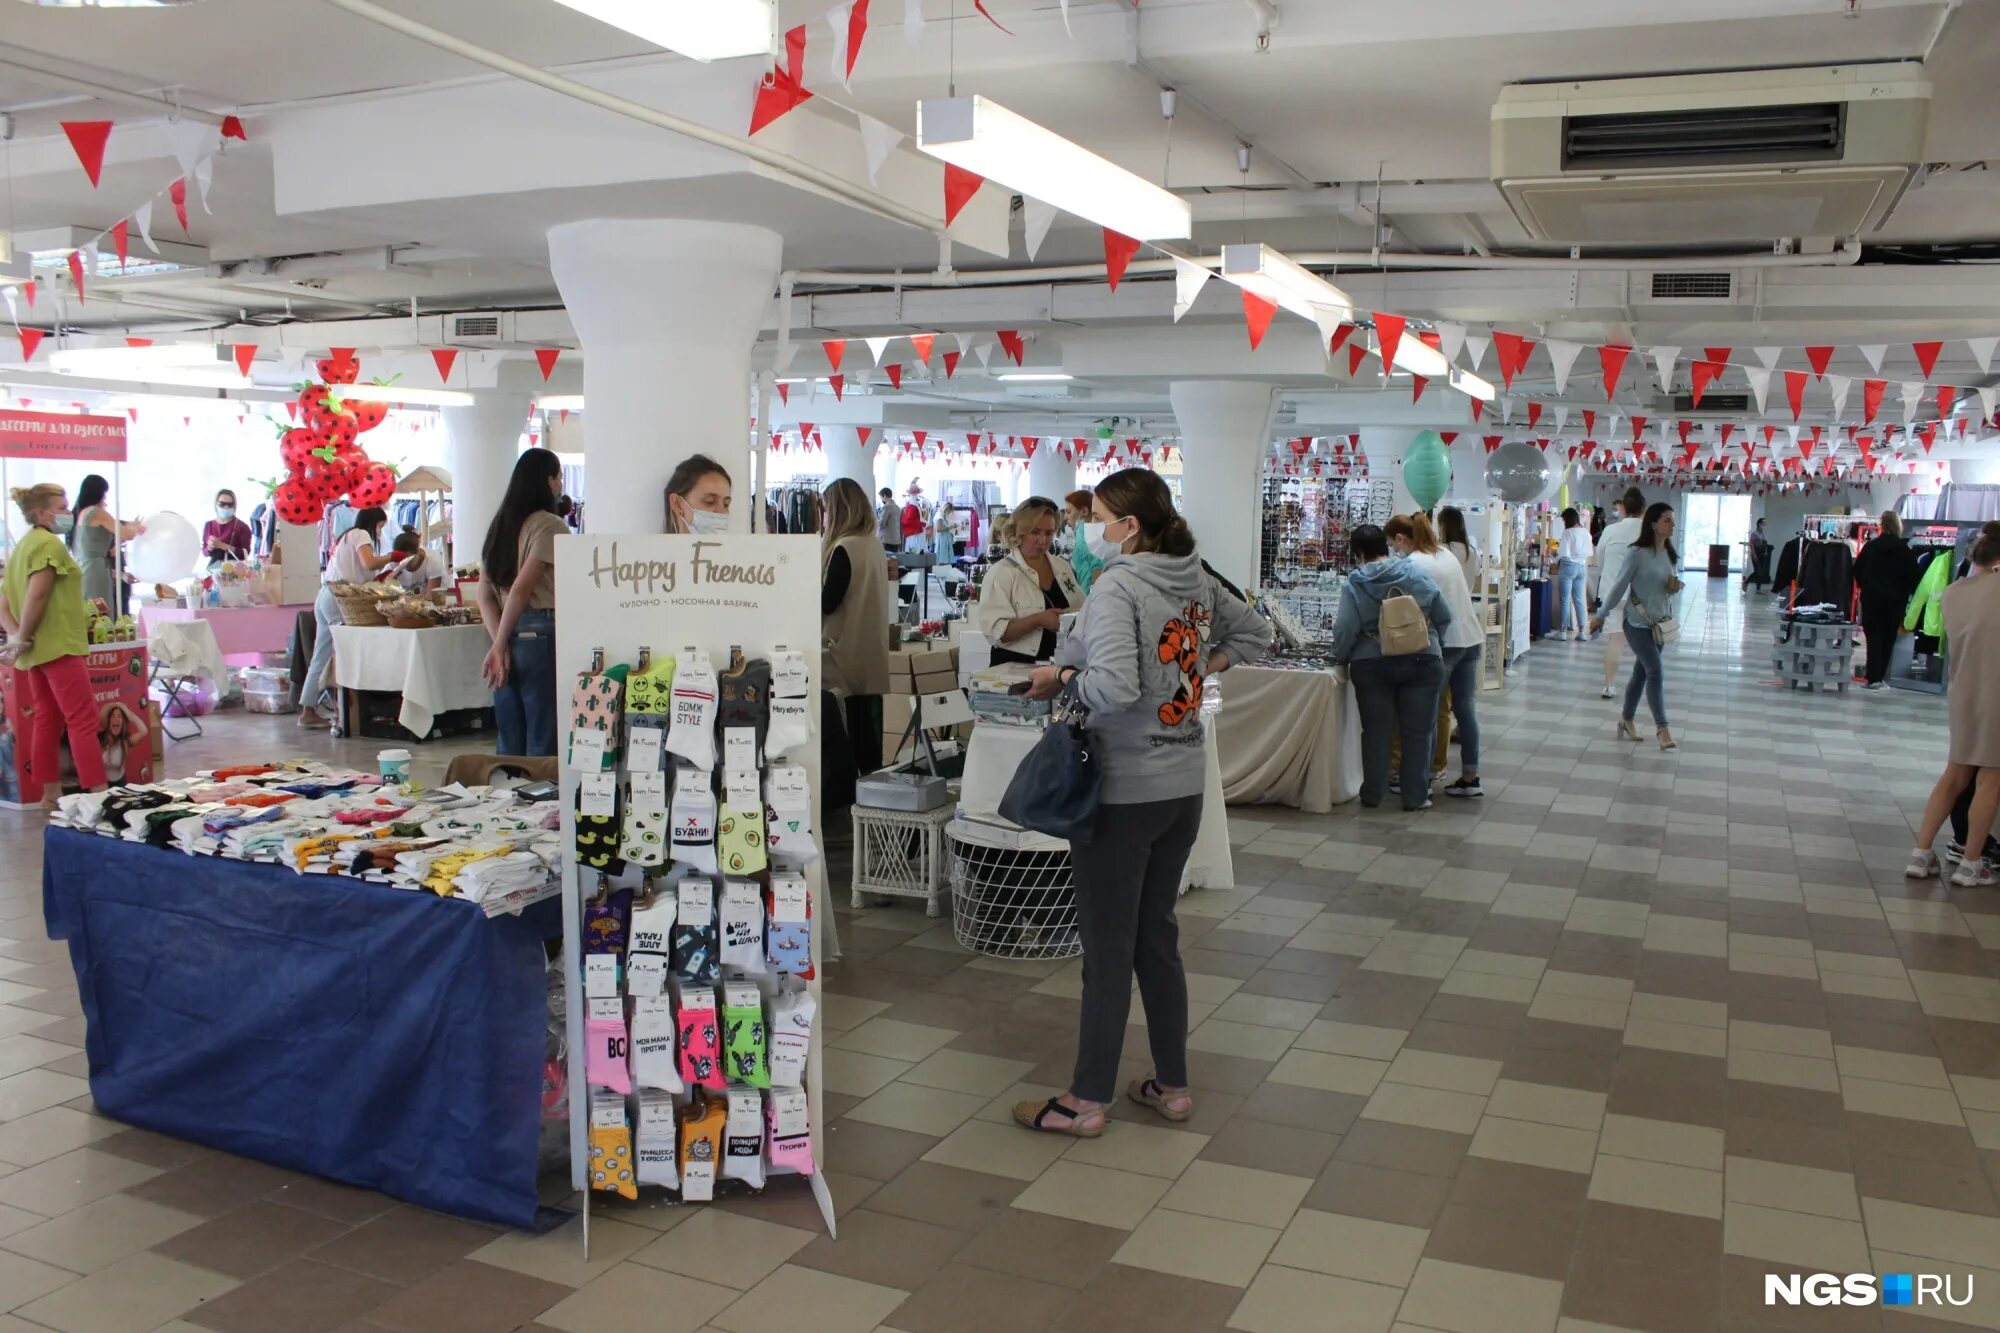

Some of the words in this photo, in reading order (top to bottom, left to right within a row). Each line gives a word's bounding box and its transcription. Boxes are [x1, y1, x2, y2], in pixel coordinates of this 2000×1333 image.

[49, 423, 71, 434] ДЛЯ
[588, 541, 676, 594] Happy
[690, 541, 776, 587] Frensis
[619, 598, 661, 609] ЧУЛОЧНО
[671, 598, 721, 606] НОСОЧНАЯ
[678, 702, 703, 714] БОМЖ
[676, 712, 702, 726] STYLE
[634, 932, 663, 941] ГАРАЖ
[738, 935, 761, 946] ШКО
[636, 1037, 650, 1045] МОЯ
[650, 1035, 670, 1044] МАМА
[640, 1043, 667, 1054] ПРОТИВ
[731, 1138, 759, 1146] ПОЛИЦИЯ
[734, 1146, 754, 1155] МОДЫ
